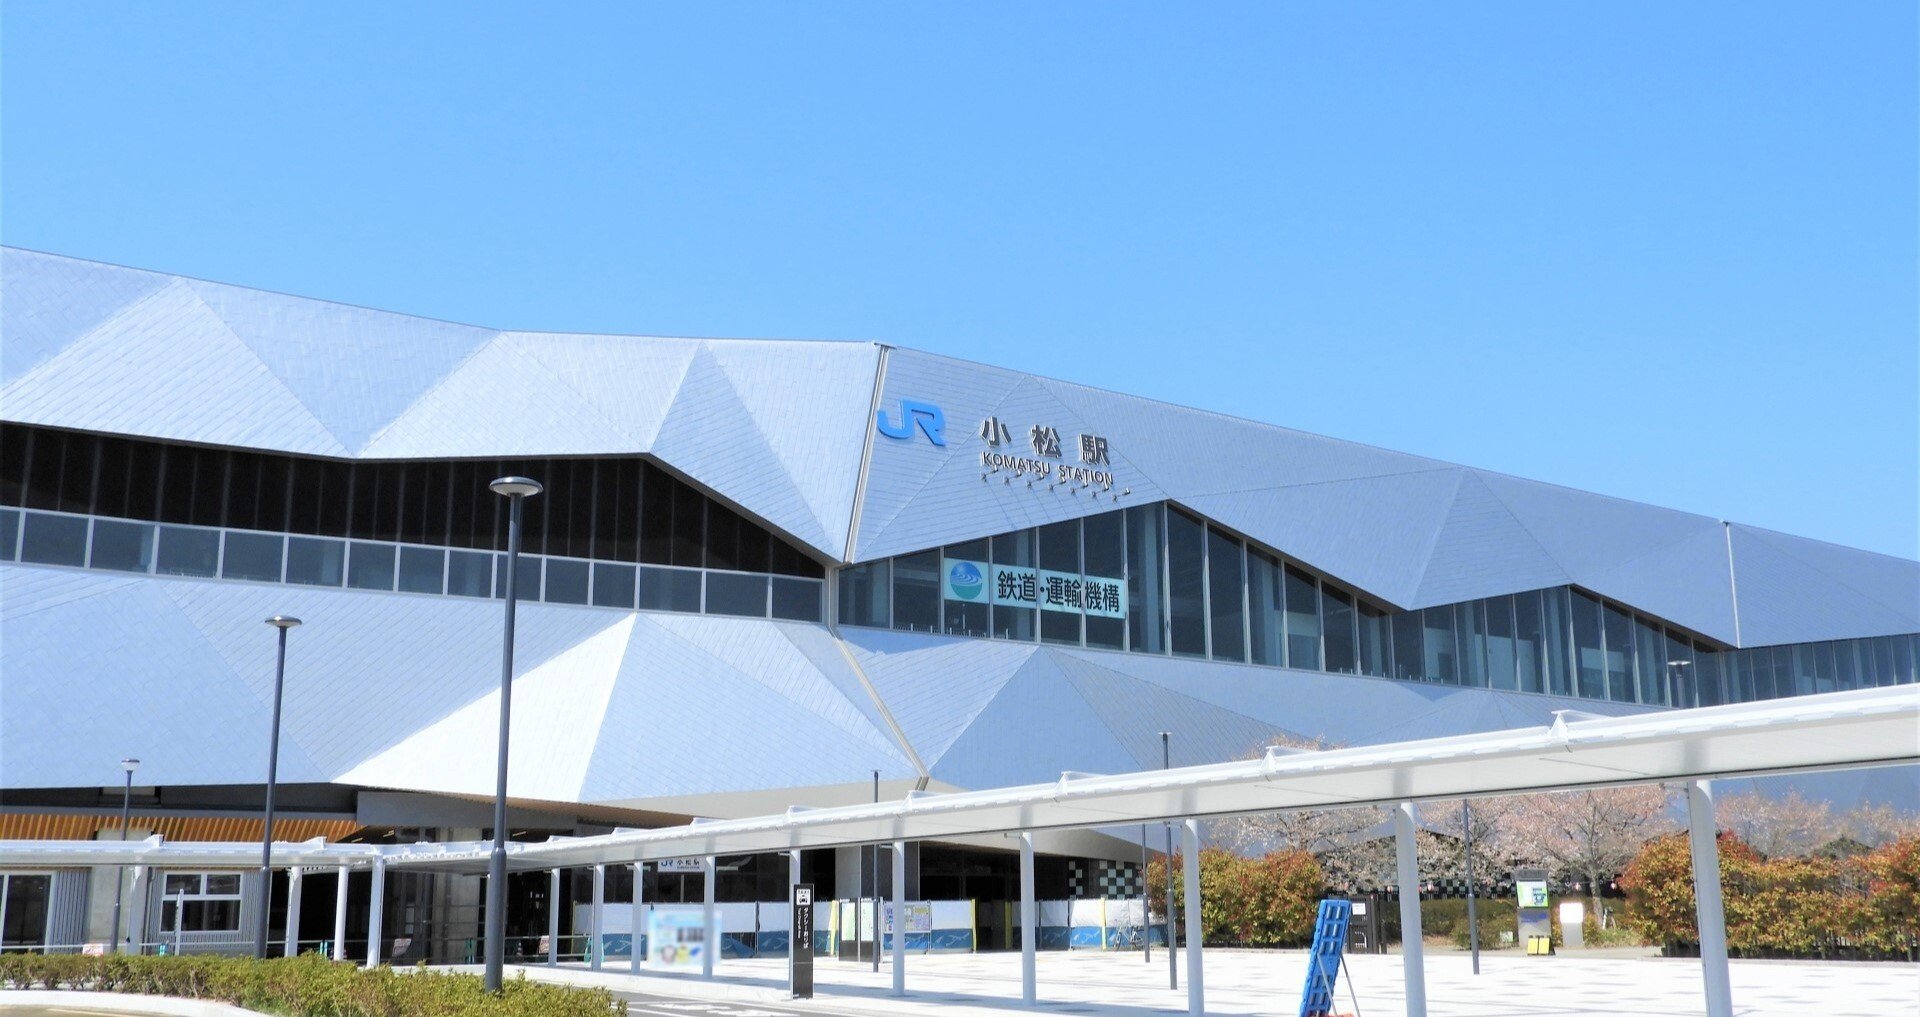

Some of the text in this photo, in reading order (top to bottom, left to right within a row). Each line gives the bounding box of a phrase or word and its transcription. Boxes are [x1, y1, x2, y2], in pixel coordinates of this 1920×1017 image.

[877, 399, 946, 447] JR
[980, 416, 1110, 468] 小松駅
[981, 450, 1114, 486] KOMATSU STATION
[997, 570, 1120, 613] 鉄道・運輸機構
